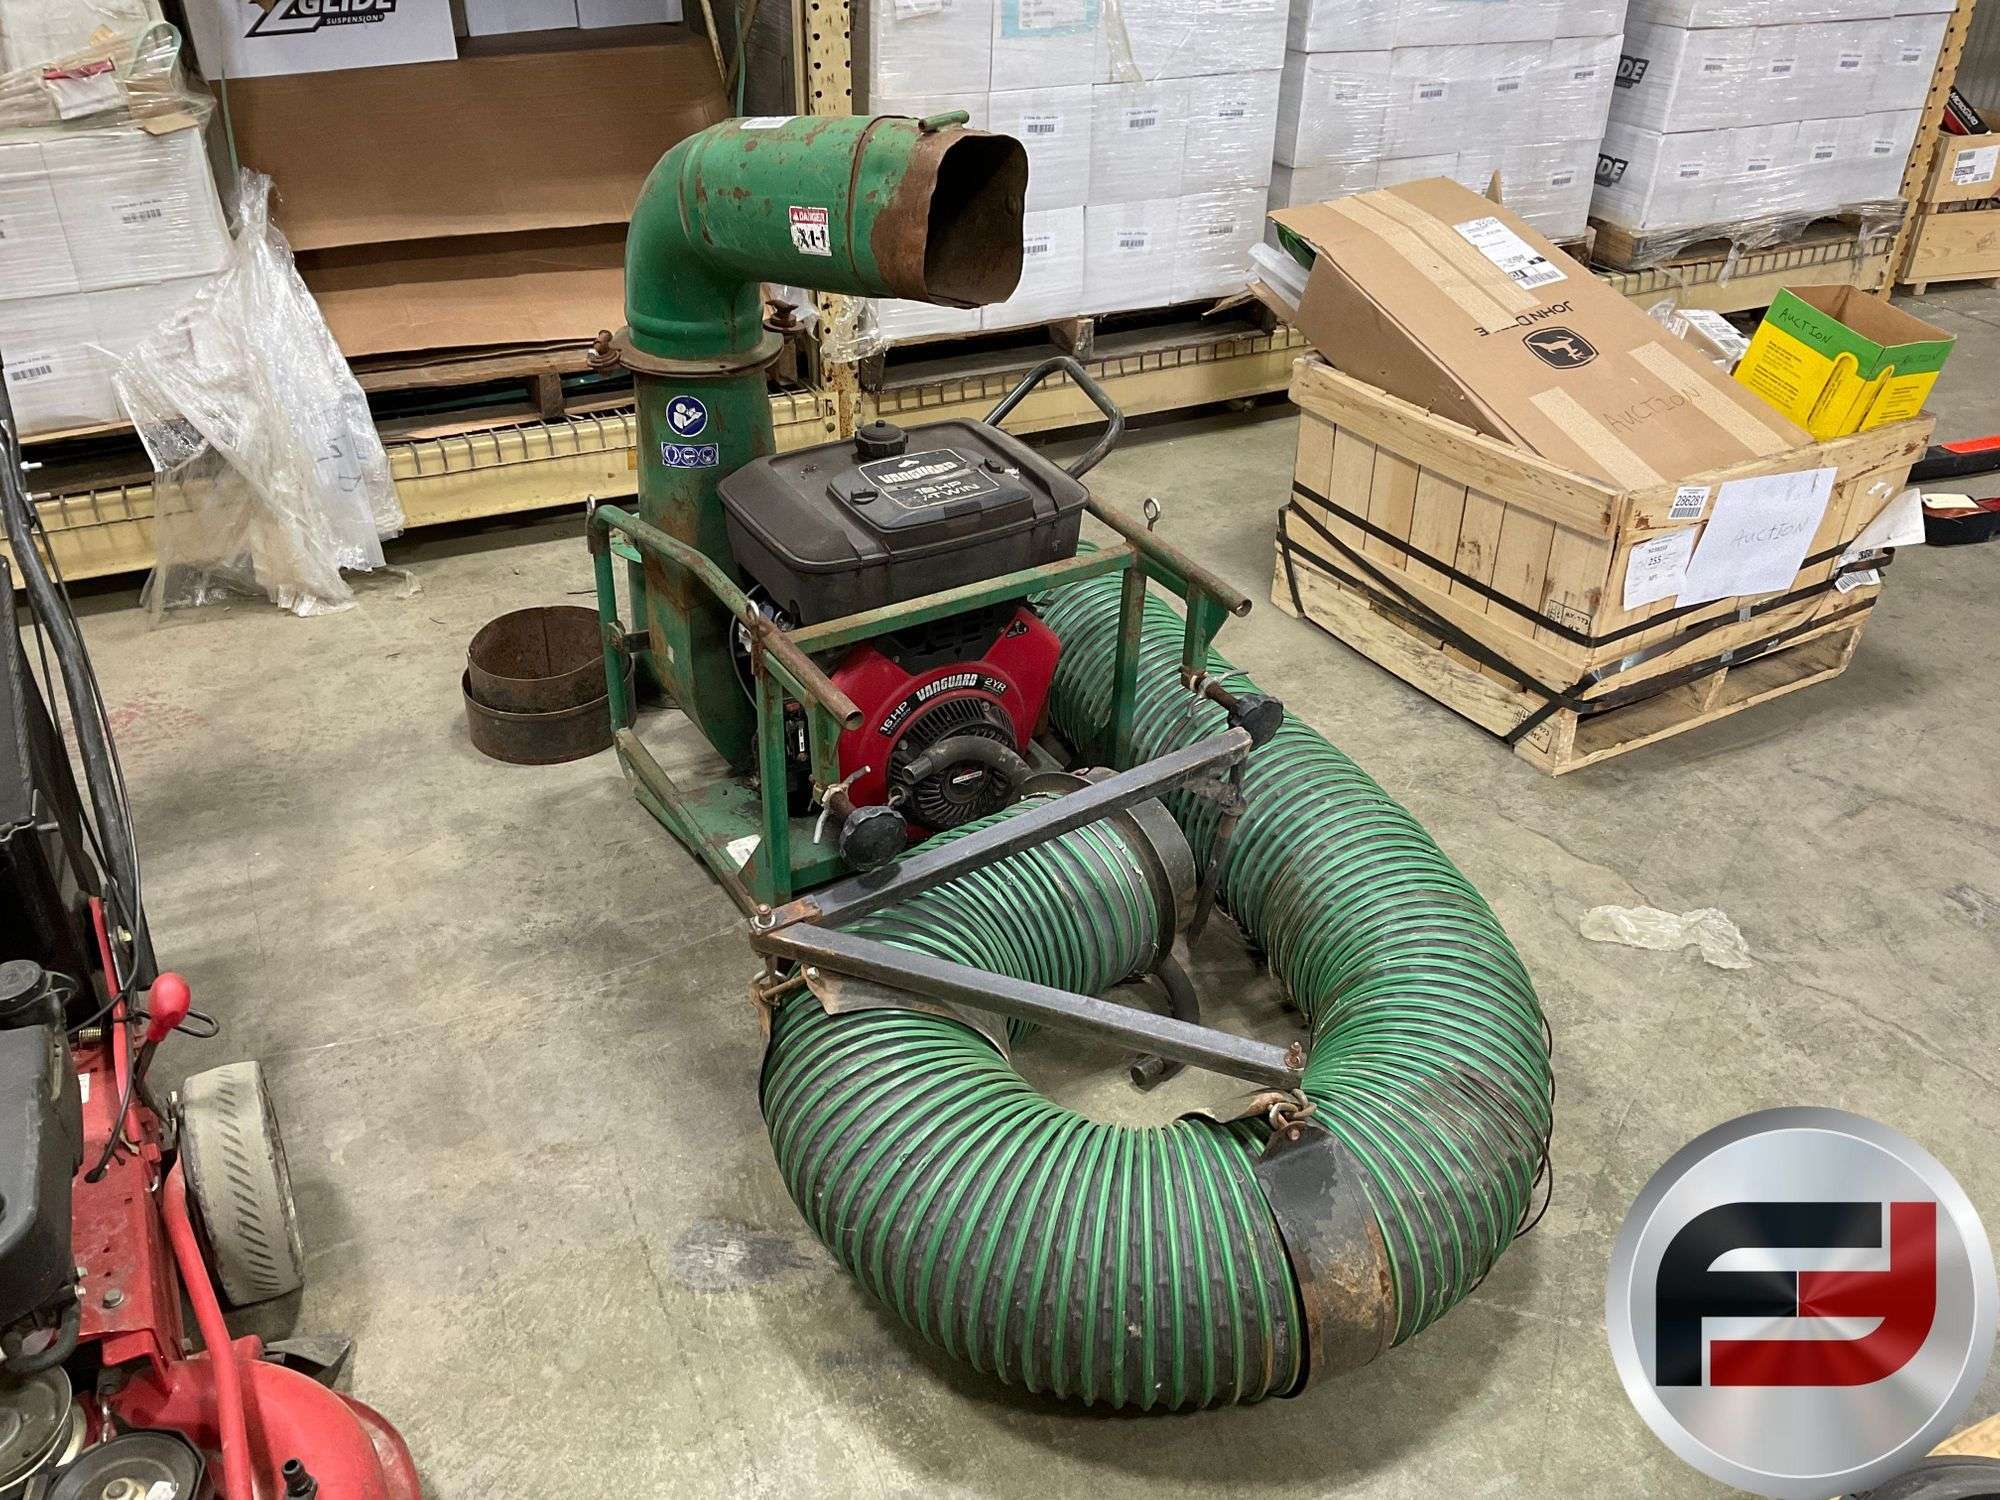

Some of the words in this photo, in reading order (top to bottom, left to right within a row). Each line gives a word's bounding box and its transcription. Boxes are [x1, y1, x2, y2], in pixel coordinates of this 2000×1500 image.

[1778, 307, 1833, 344] AUCTION
[1602, 385, 1701, 432] AUCTION
[877, 461, 958, 484] VANGUARD
[1675, 495, 1704, 507] 286281
[1731, 517, 1809, 548] AUCTION
[916, 673, 978, 702] VANGUARD
